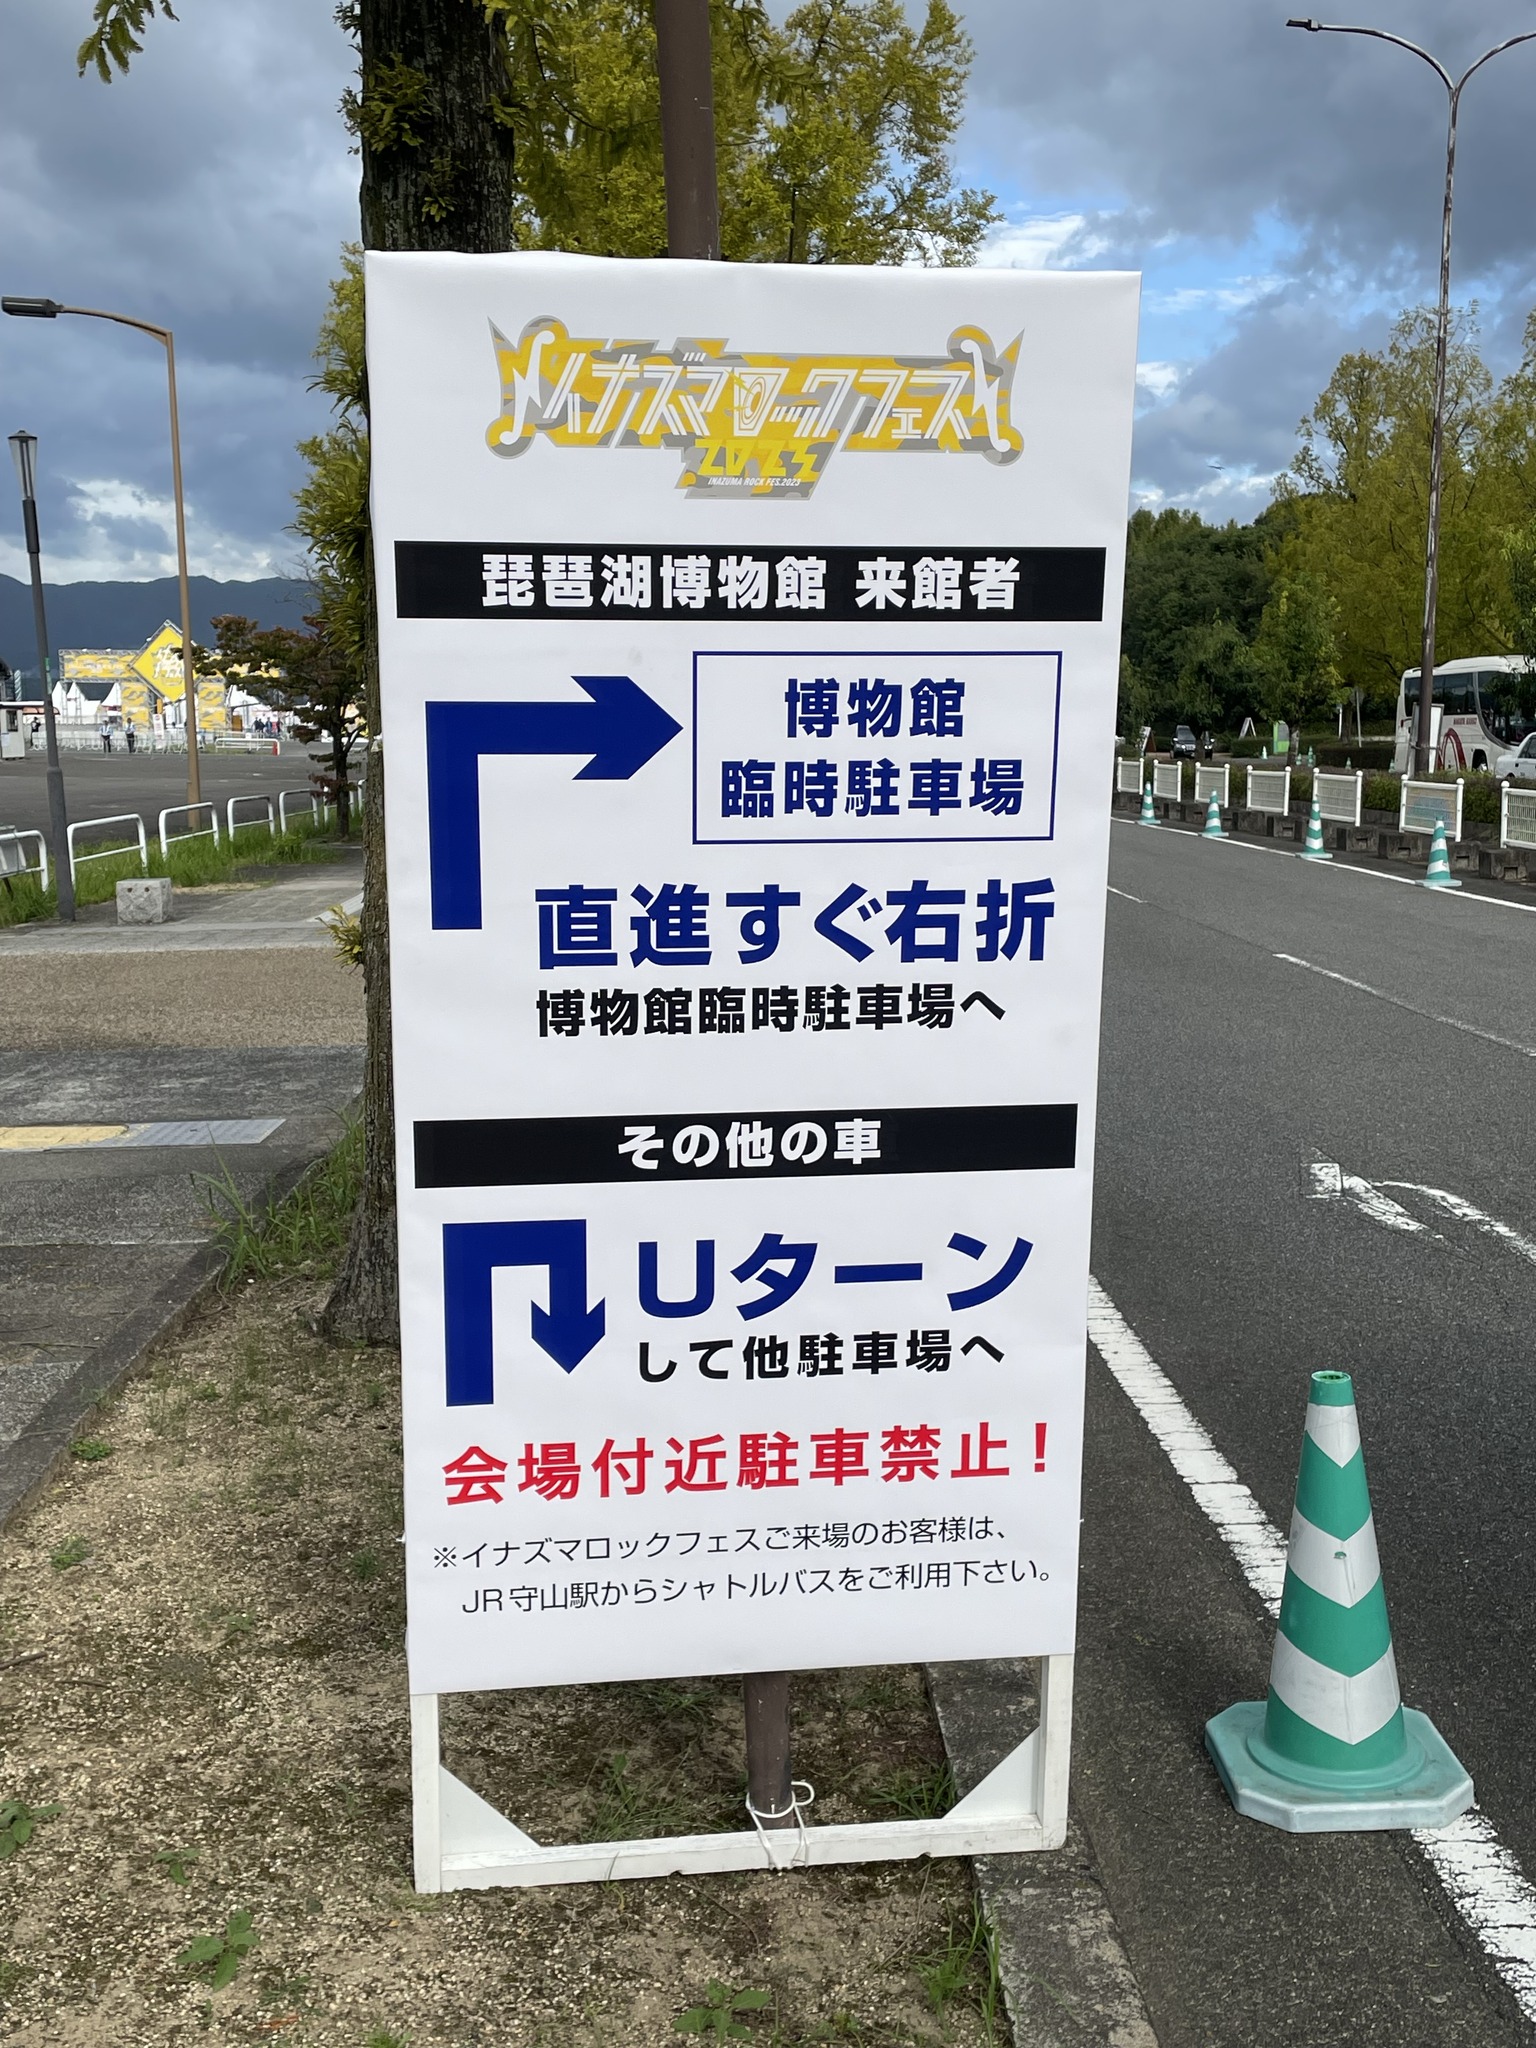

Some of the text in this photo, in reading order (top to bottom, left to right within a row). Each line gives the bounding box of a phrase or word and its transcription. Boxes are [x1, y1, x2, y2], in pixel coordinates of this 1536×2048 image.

[543, 351, 972, 439] イナズマロックフェス
[694, 438, 821, 479] 2023
[708, 477, 802, 488] INAZUMA ROCK FES.2023
[481, 553, 1020, 611] 琵琶湖博物館 来館者
[785, 678, 966, 739] 博物館
[720, 758, 1025, 819] 臨時駐車場
[535, 877, 1055, 970] 直進すぐ右折
[535, 982, 1006, 1038] 博物館臨時駐車場へ
[617, 1118, 882, 1170] その他の車
[638, 1232, 1034, 1322] Uターン
[639, 1329, 1005, 1383] して他駐車場へ
[442, 1421, 1049, 1506] 会場付近駐車禁止！
